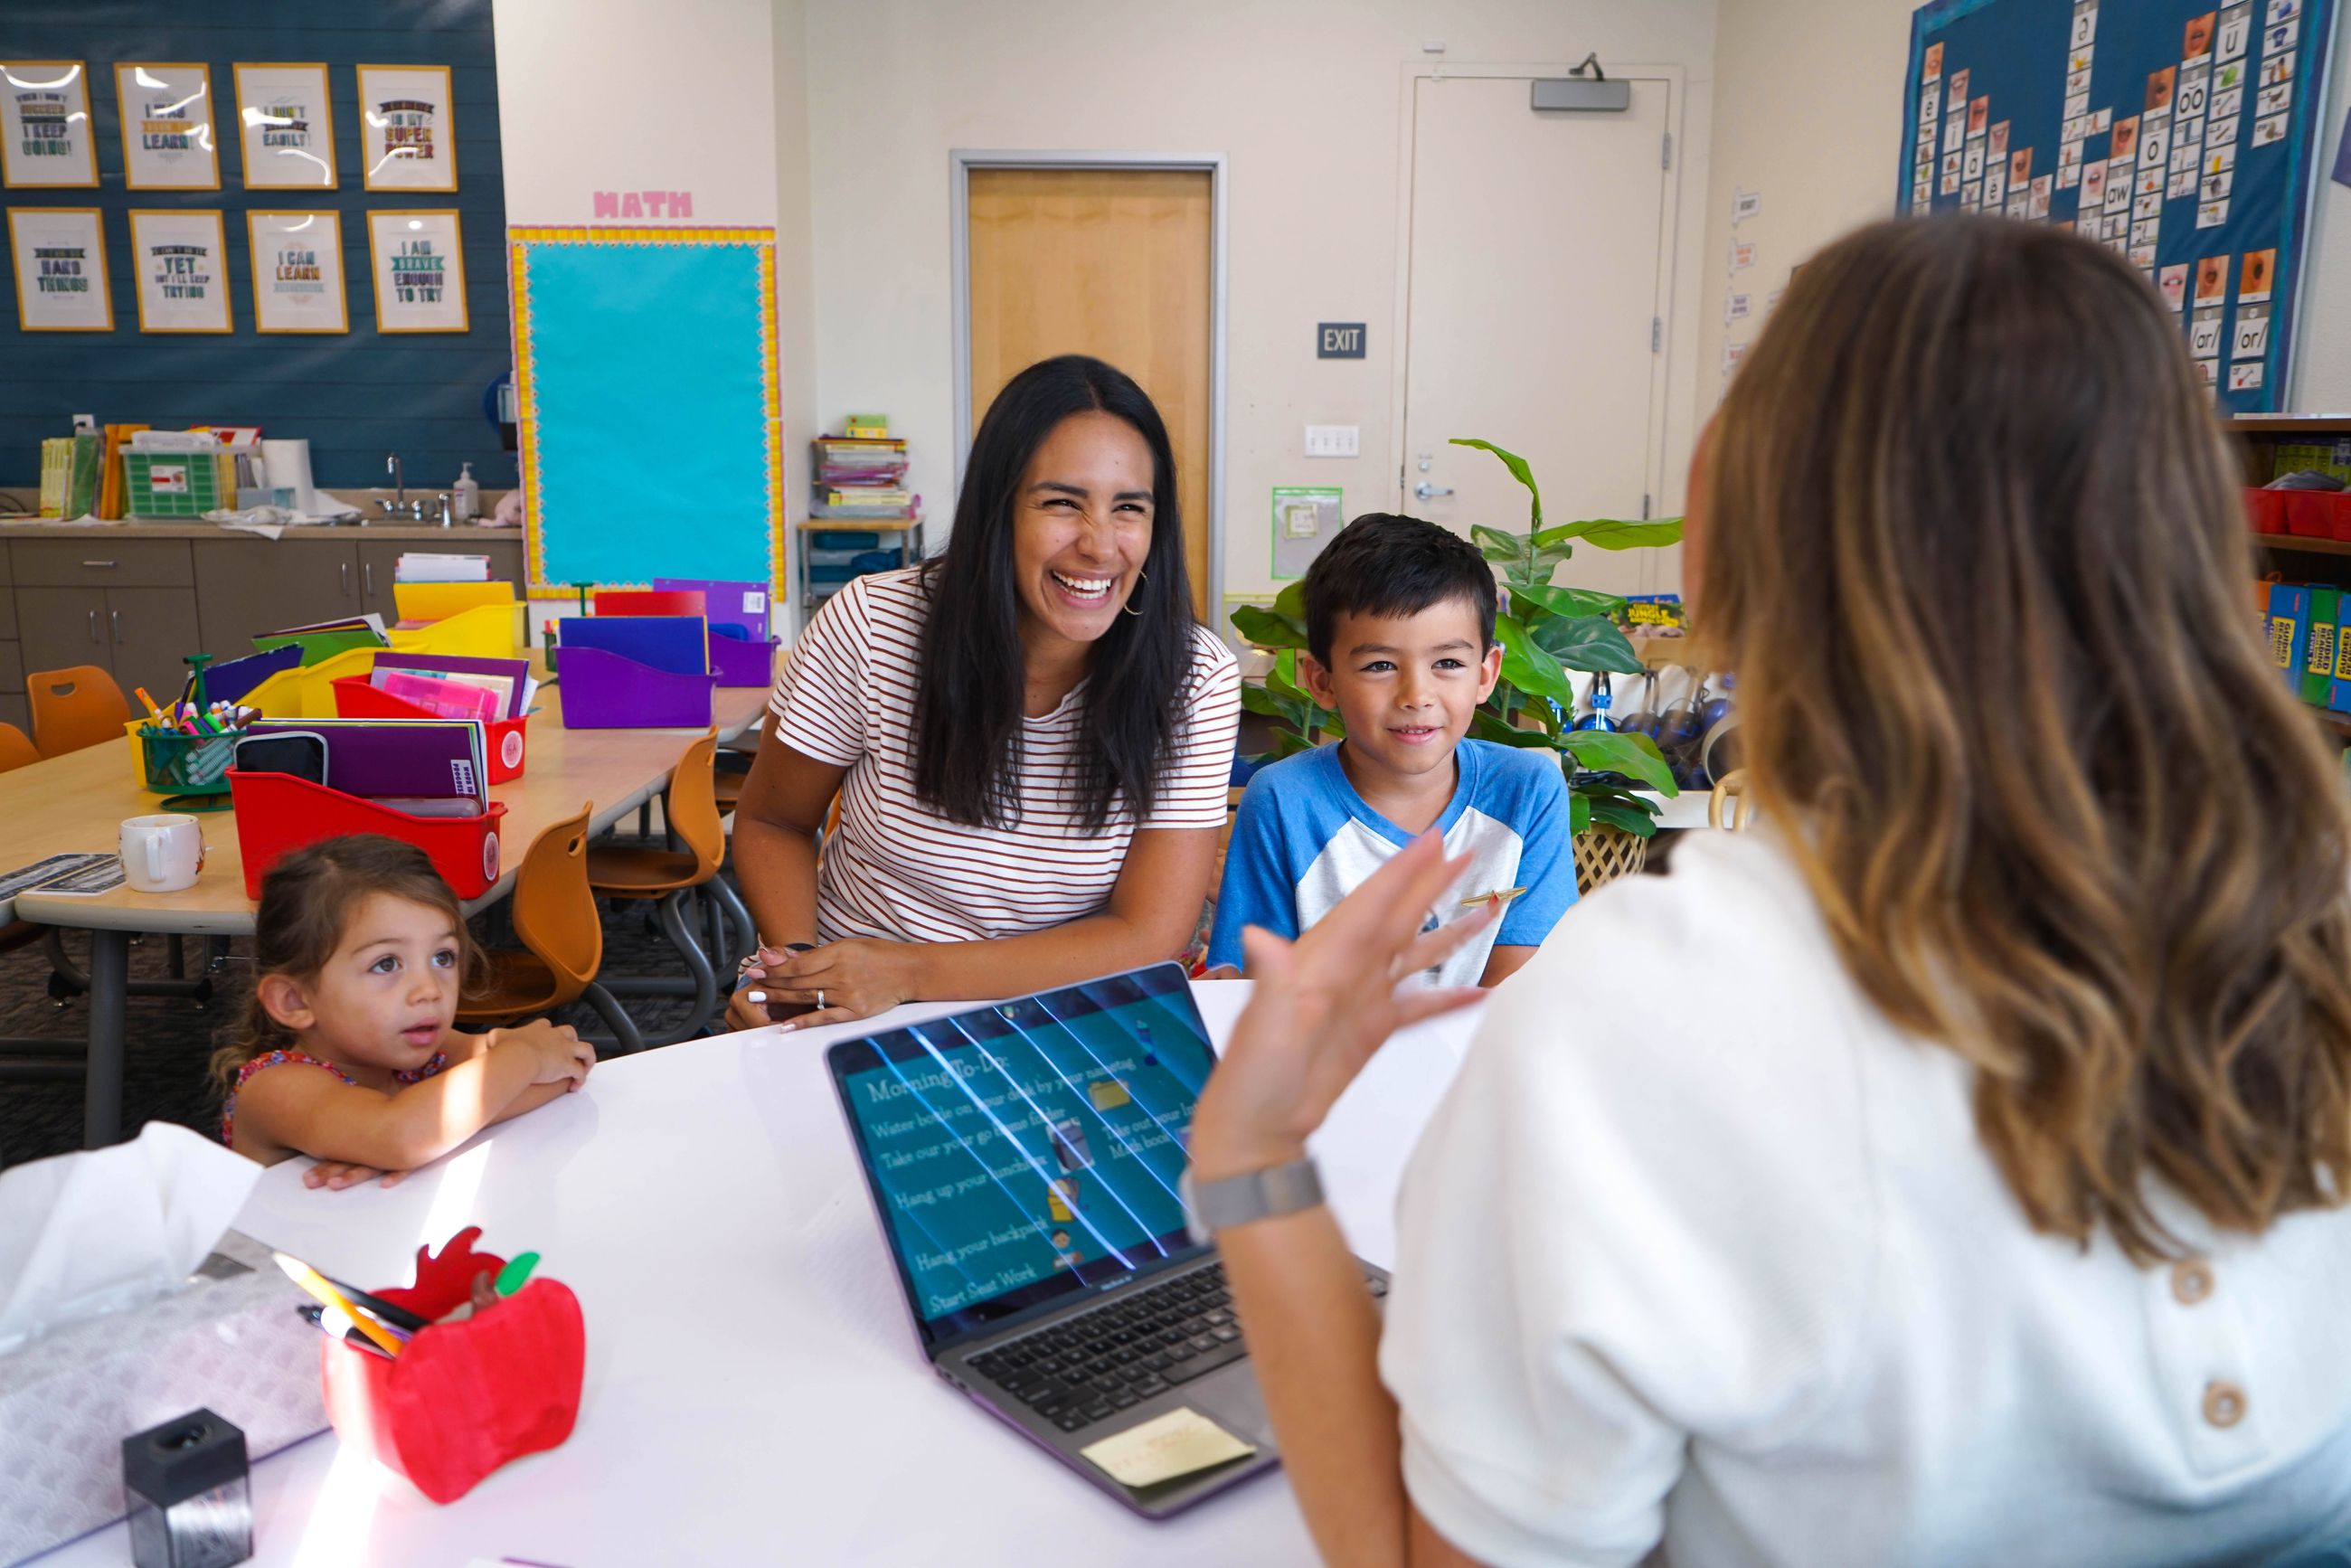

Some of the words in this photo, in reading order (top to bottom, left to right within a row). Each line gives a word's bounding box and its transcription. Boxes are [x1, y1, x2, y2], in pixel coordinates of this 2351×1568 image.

[144, 102, 151, 118] I
[23, 124, 29, 138] I
[33, 124, 68, 138] KEEP
[262, 132, 312, 147] EASILY!
[384, 127, 434, 142] SUPER
[22, 139, 71, 156] GOING!
[142, 134, 194, 151] LEARN!
[385, 143, 434, 159] POWER
[593, 191, 693, 219] MATH
[401, 240, 406, 255] I
[411, 239, 431, 255] AM
[163, 257, 195, 274] YET
[277, 250, 283, 265] I
[287, 250, 315, 265] CAN
[398, 258, 438, 270] BRAVE
[41, 260, 80, 275] HARD
[276, 265, 320, 281] LEARN
[37, 276, 89, 292] THINGS
[394, 272, 444, 287] ENOUGH
[162, 285, 204, 298] TRYING
[396, 288, 414, 303] TO
[418, 288, 442, 303] TRY
[1324, 328, 1361, 353] EXIT
[2280, 622, 2291, 664] GUIDED
[2316, 628, 2327, 669] READING
[2322, 628, 2333, 670] GUIDED
[2338, 631, 2350, 675] GUIDED
[464, 766, 472, 785] WORK
[866, 1071, 955, 1102] Morning
[871, 1119, 915, 1138] Water
[956, 1104, 973, 1117] on
[1036, 1074, 1054, 1094] by
[1054, 1071, 1084, 1091] your
[1133, 1117, 1152, 1133] out
[880, 1149, 914, 1170] Take
[943, 1135, 974, 1156] your
[977, 1129, 993, 1147] go
[1109, 1138, 1144, 1160] Math
[1143, 1131, 1170, 1150] book
[895, 1191, 937, 1209] Hang
[937, 1185, 955, 1200] up
[956, 1174, 988, 1195] your
[915, 1251, 957, 1271] Hang
[957, 1239, 989, 1261] your
[988, 1214, 1049, 1247] backpack
[930, 1291, 966, 1313] Start
[968, 1280, 998, 1299] Seat
[997, 1262, 1037, 1287] Work
